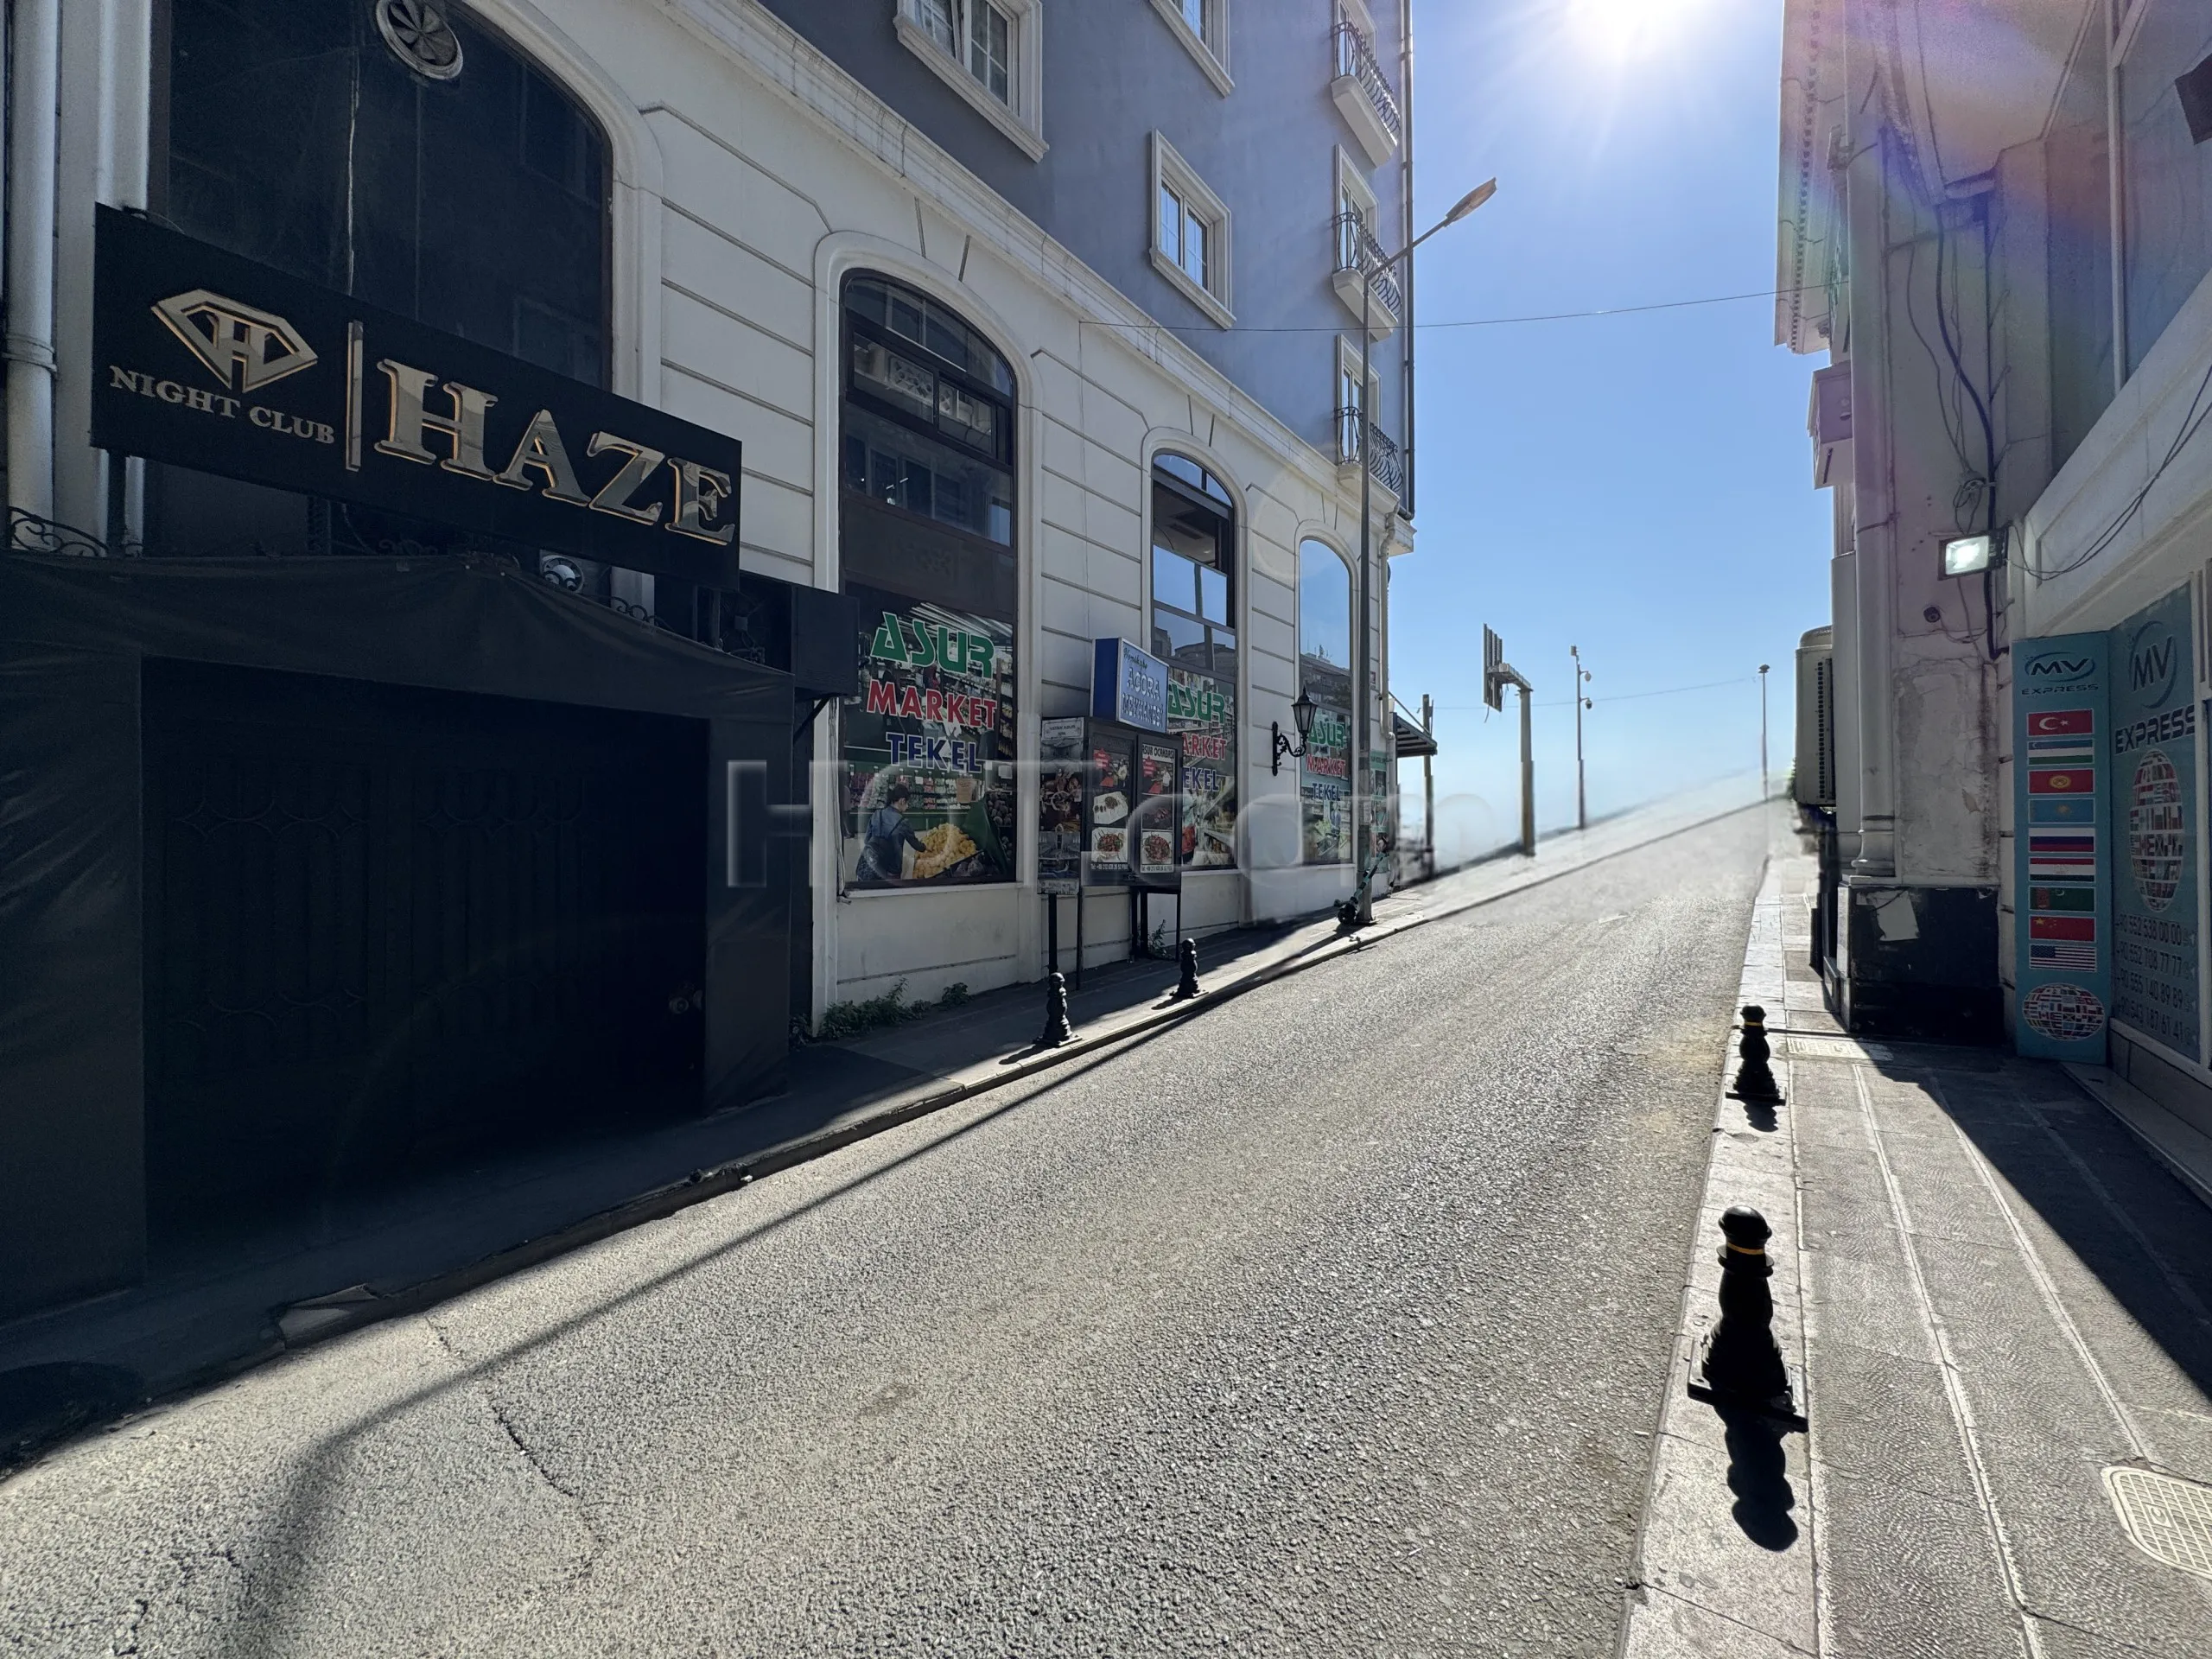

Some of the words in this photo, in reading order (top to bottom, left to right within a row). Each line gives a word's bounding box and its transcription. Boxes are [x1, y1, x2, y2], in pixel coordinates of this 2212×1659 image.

[109, 365, 241, 419] NIGHT
[249, 406, 335, 445] CLUB
[372, 359, 735, 545] HAZE
[870, 611, 995, 679] ASUR
[2133, 635, 2173, 692] MV
[1127, 666, 1160, 702] AGORA
[2031, 658, 2089, 676] MV
[866, 679, 997, 729] MARKET
[2021, 683, 2100, 696] EXPRESS
[1182, 733, 1227, 760] ARKET
[2115, 703, 2195, 755] EXPRESS
[886, 731, 982, 773] TEKEL
[1306, 753, 1346, 777] MARKET
[1182, 765, 1220, 792] EKEL
[1312, 782, 1341, 801] TEKEL
